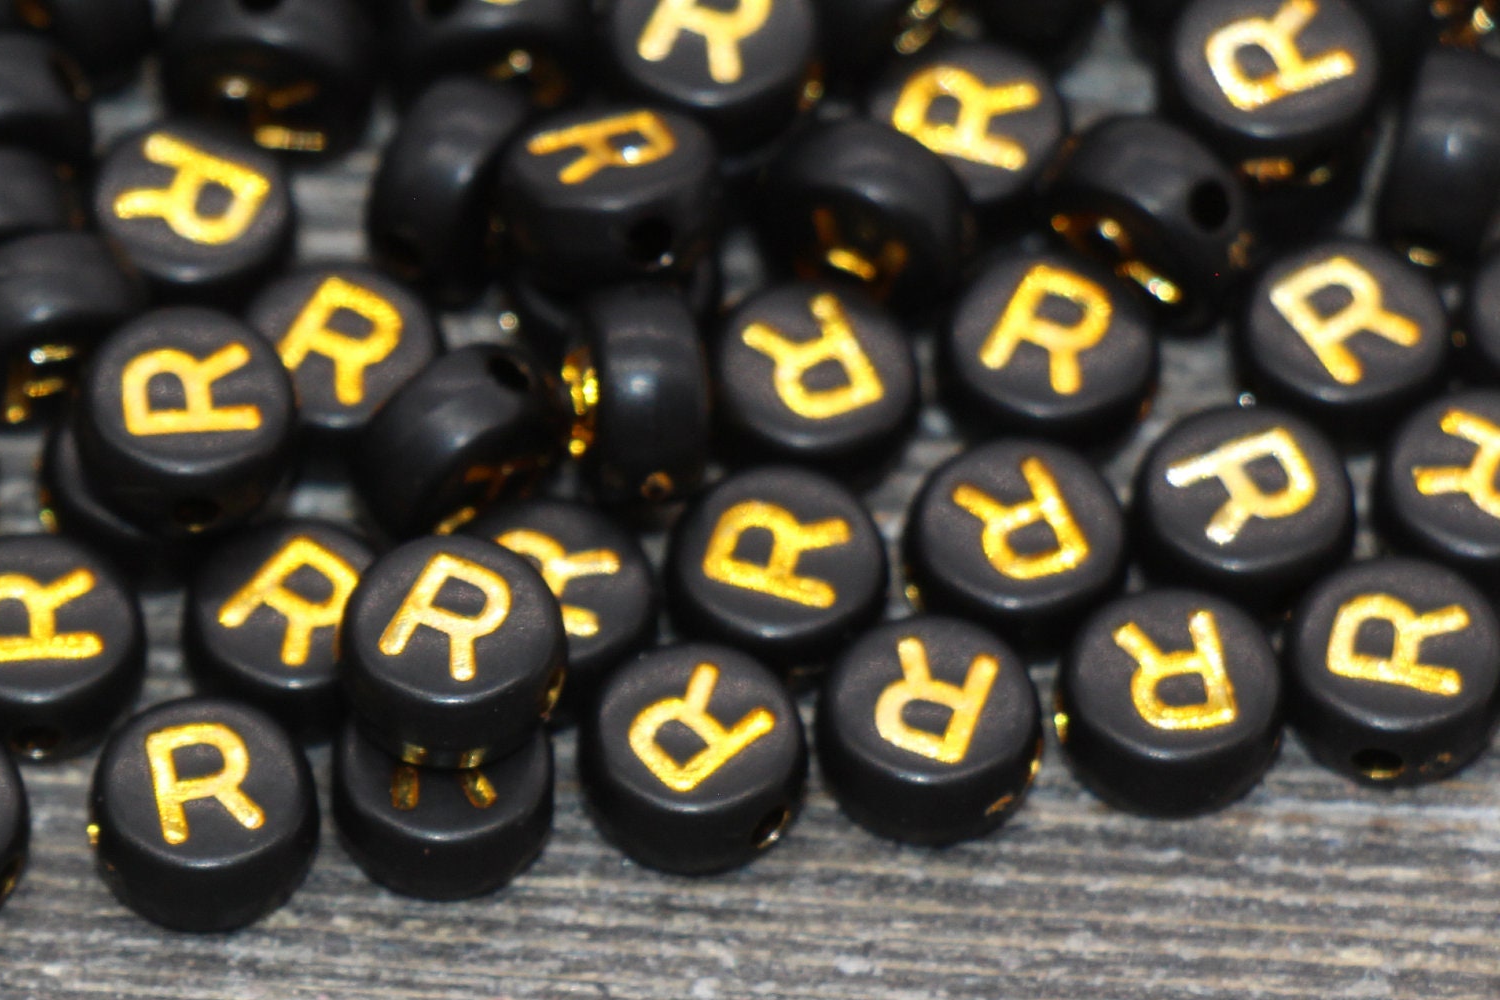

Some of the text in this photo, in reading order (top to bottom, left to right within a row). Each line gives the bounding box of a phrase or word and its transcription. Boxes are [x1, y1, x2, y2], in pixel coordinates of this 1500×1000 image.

[1205, 0, 1356, 112] R
[528, 110, 676, 184] R
[891, 66, 1040, 171] R
[113, 134, 271, 246] R
[278, 277, 402, 406] R
[742, 296, 885, 420] R
[980, 264, 1113, 395] R
[1268, 256, 1421, 386] R
[121, 342, 263, 437] R
[954, 459, 1090, 581] R
[1165, 426, 1318, 546] R
[219, 537, 358, 667] R
[703, 500, 851, 609] R
[378, 553, 512, 682] R
[1112, 611, 1238, 731] R
[1326, 594, 1471, 697] R
[628, 663, 775, 793] R
[875, 638, 999, 765] R
[146, 723, 266, 845] R
